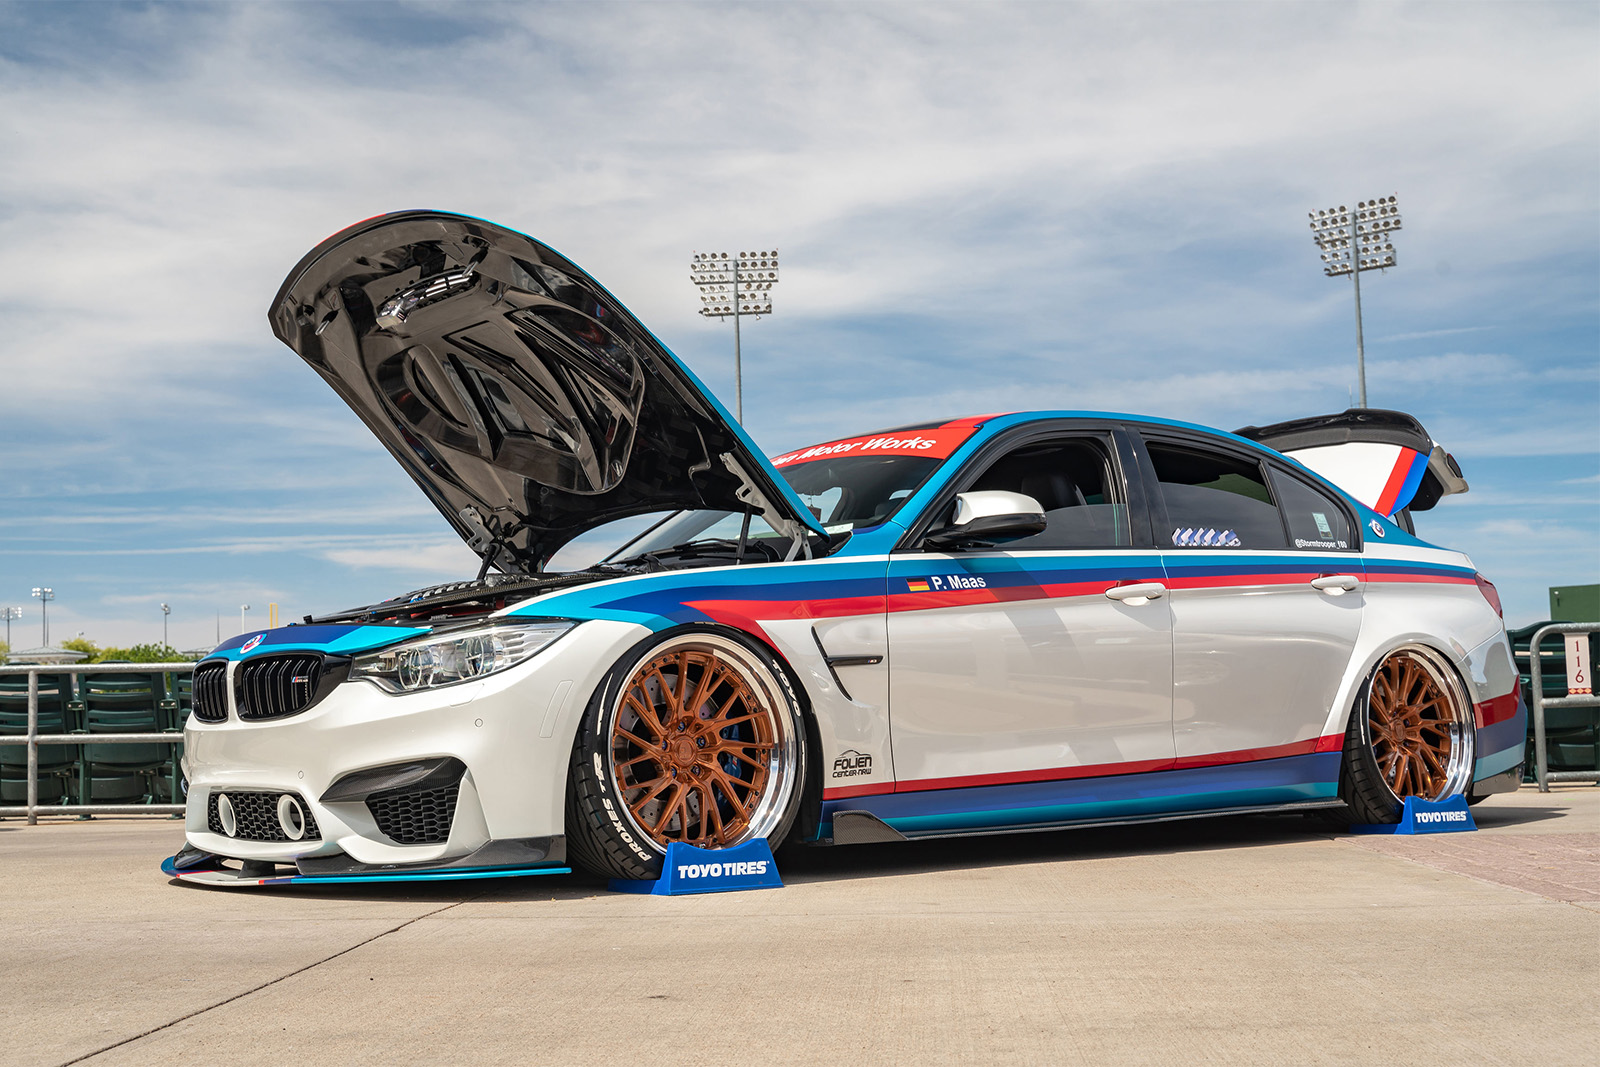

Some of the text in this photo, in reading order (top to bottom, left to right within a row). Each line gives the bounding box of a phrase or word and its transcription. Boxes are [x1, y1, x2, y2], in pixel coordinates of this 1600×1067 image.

[796, 442, 862, 460] Motor
[861, 436, 937, 450] Works
[931, 575, 987, 590] P. Maas
[1575, 640, 1585, 683] 116
[772, 659, 801, 717] TOYO
[833, 756, 872, 770] FOLIEN
[1415, 810, 1467, 823] TOYO TIRES
[602, 798, 652, 861] PROXES
[678, 860, 767, 879] TOYO TIRES
